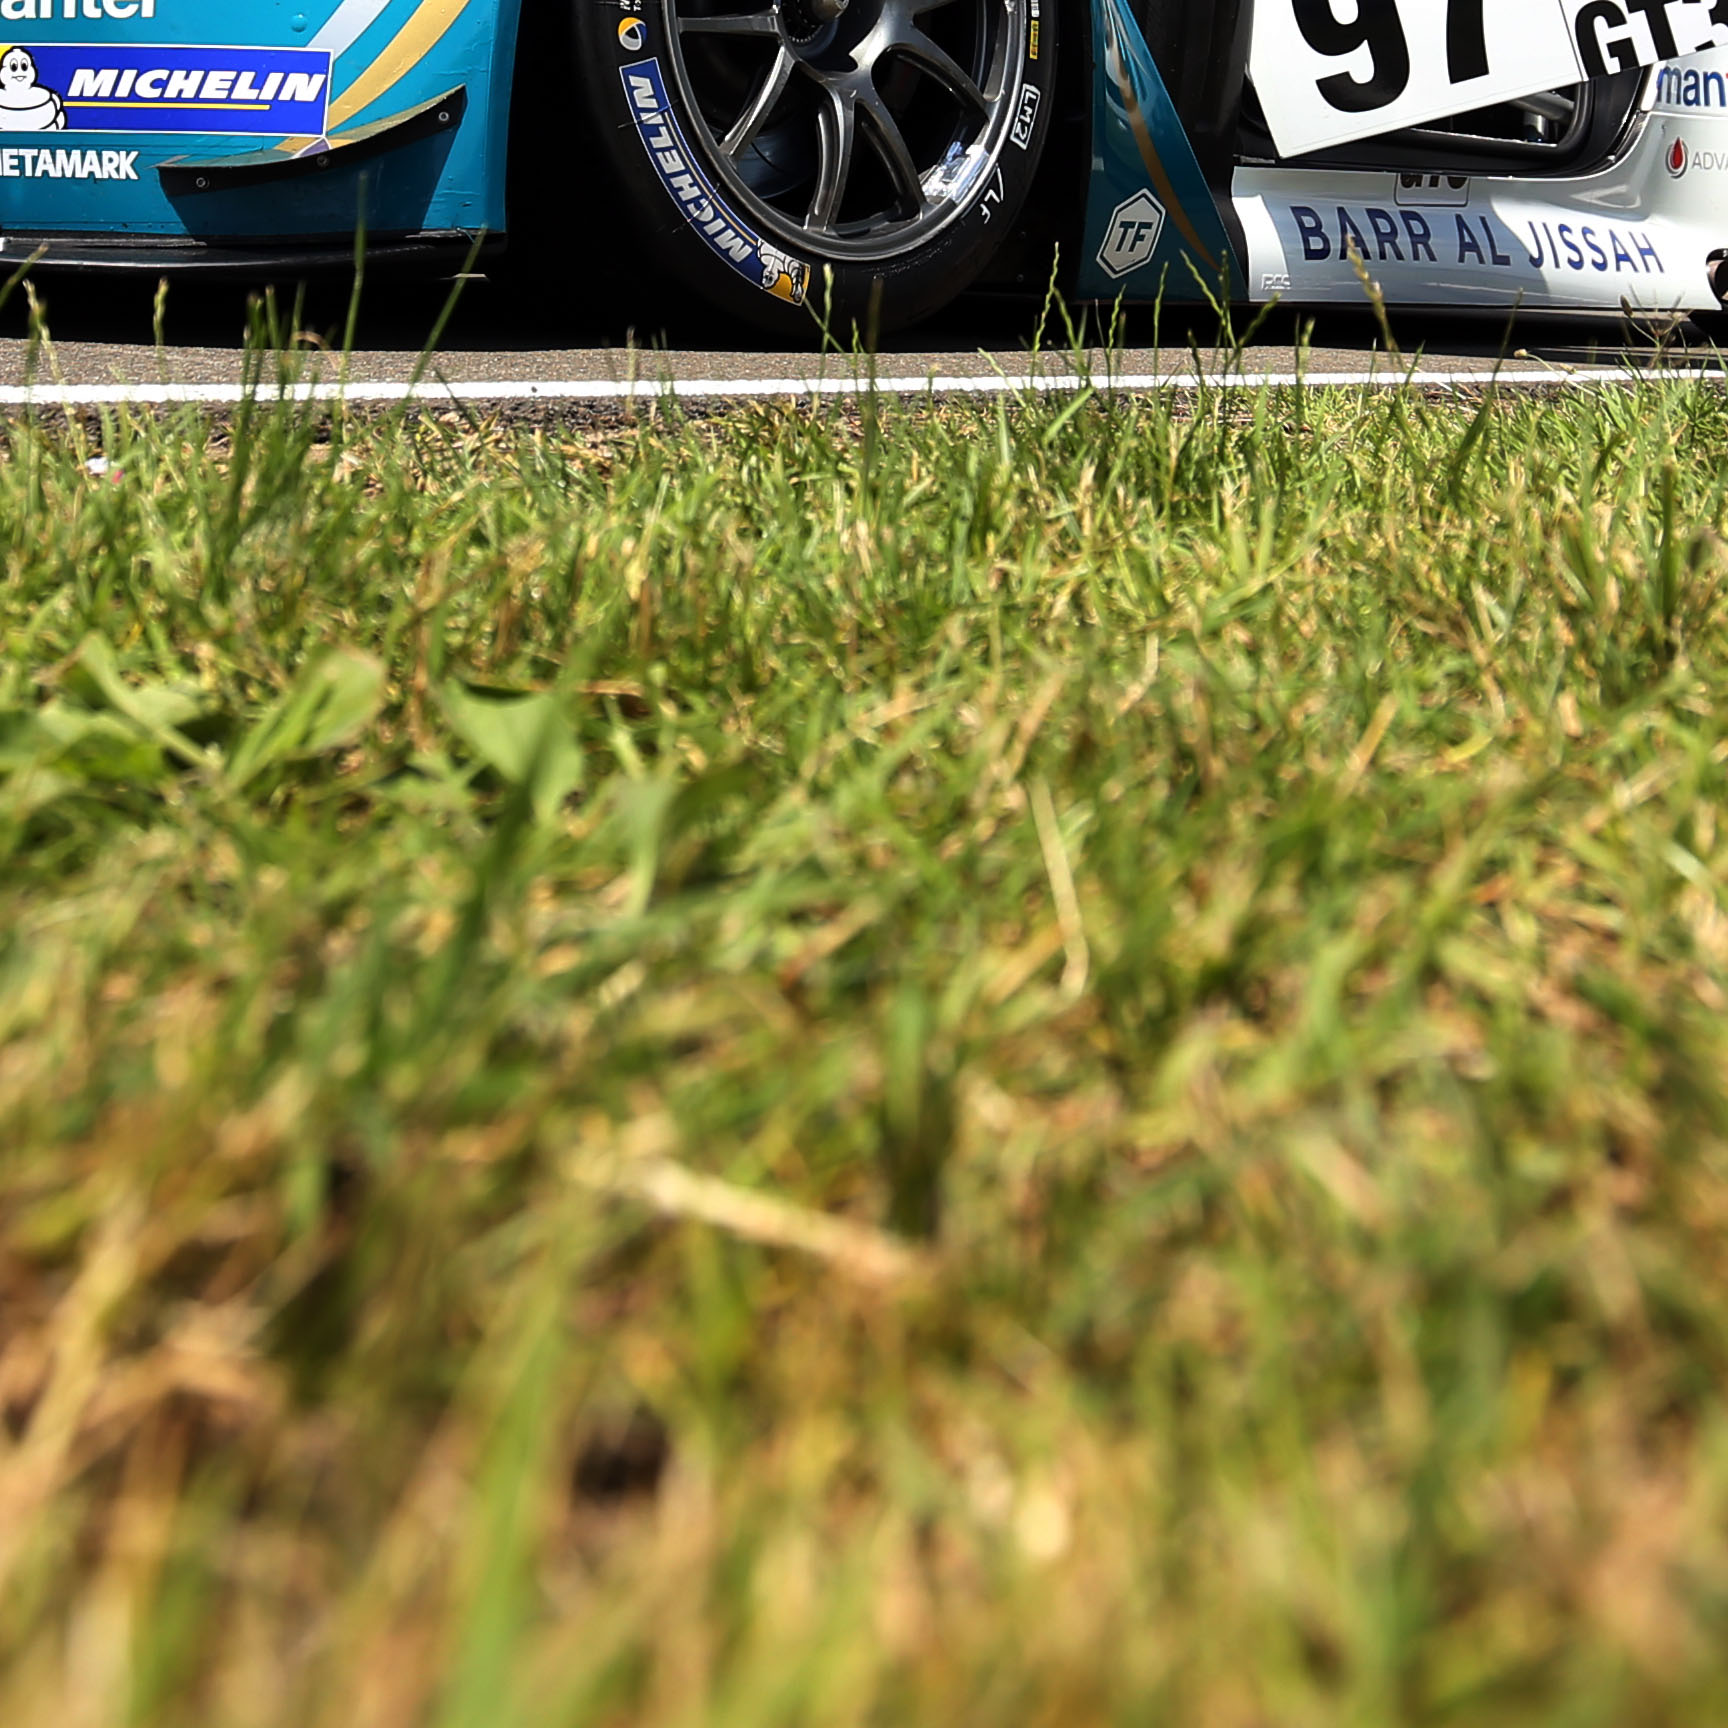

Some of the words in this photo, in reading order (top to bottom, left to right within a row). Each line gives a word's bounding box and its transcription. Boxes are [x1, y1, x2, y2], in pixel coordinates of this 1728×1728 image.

[67, 68, 326, 102] MICHELIN
[628, 74, 754, 263] MICHELIN
[1115, 220, 1154, 253] TF
[1289, 205, 1438, 263] BARR
[1455, 210, 1513, 268] AL
[1526, 220, 1666, 273] JISSAH
